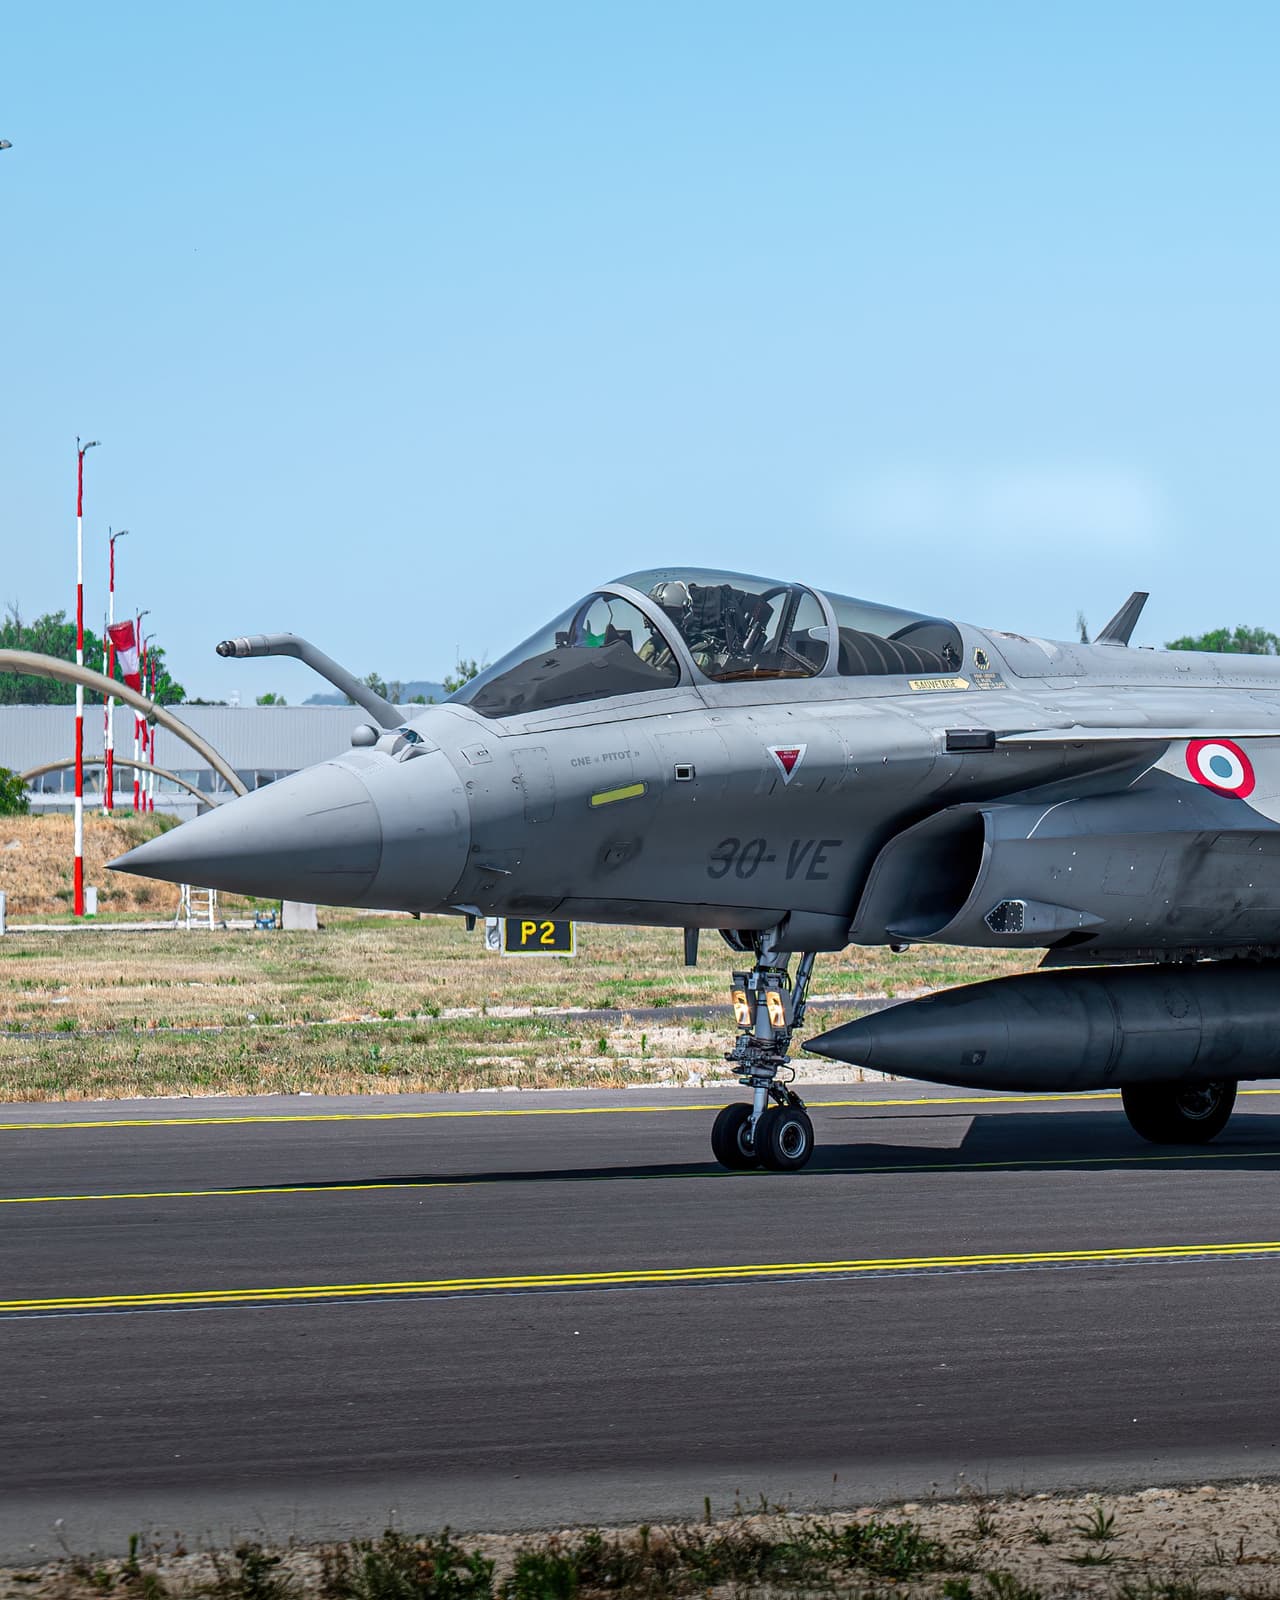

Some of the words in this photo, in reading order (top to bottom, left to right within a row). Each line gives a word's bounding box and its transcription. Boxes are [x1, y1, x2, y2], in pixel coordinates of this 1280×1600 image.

[570, 756, 592, 768] CNE
[602, 750, 631, 762] PITOT
[706, 837, 844, 881] 30-VE
[521, 920, 556, 945] P2
